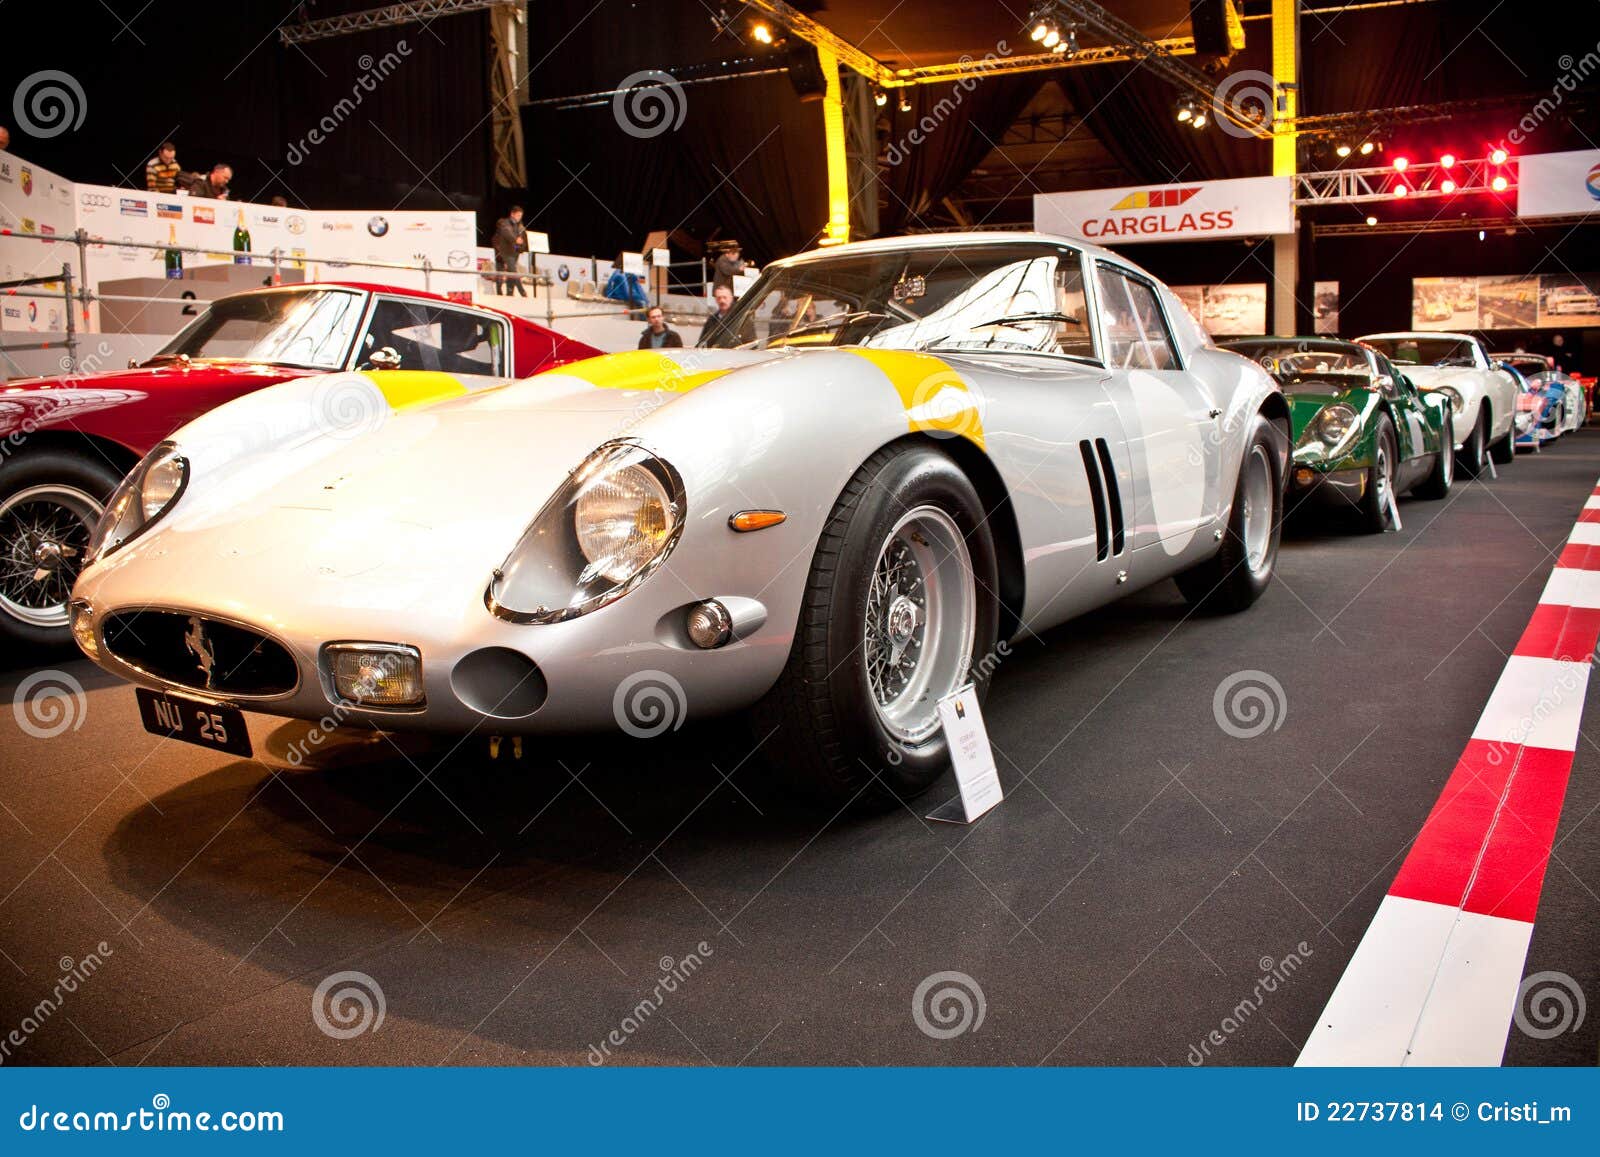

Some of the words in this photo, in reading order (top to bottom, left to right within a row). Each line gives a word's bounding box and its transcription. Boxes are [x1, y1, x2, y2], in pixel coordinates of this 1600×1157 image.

[1082, 210, 1234, 238] CARGLASS
[181, 290, 197, 316] 2
[153, 699, 184, 732] NU
[196, 711, 228, 744] 25
